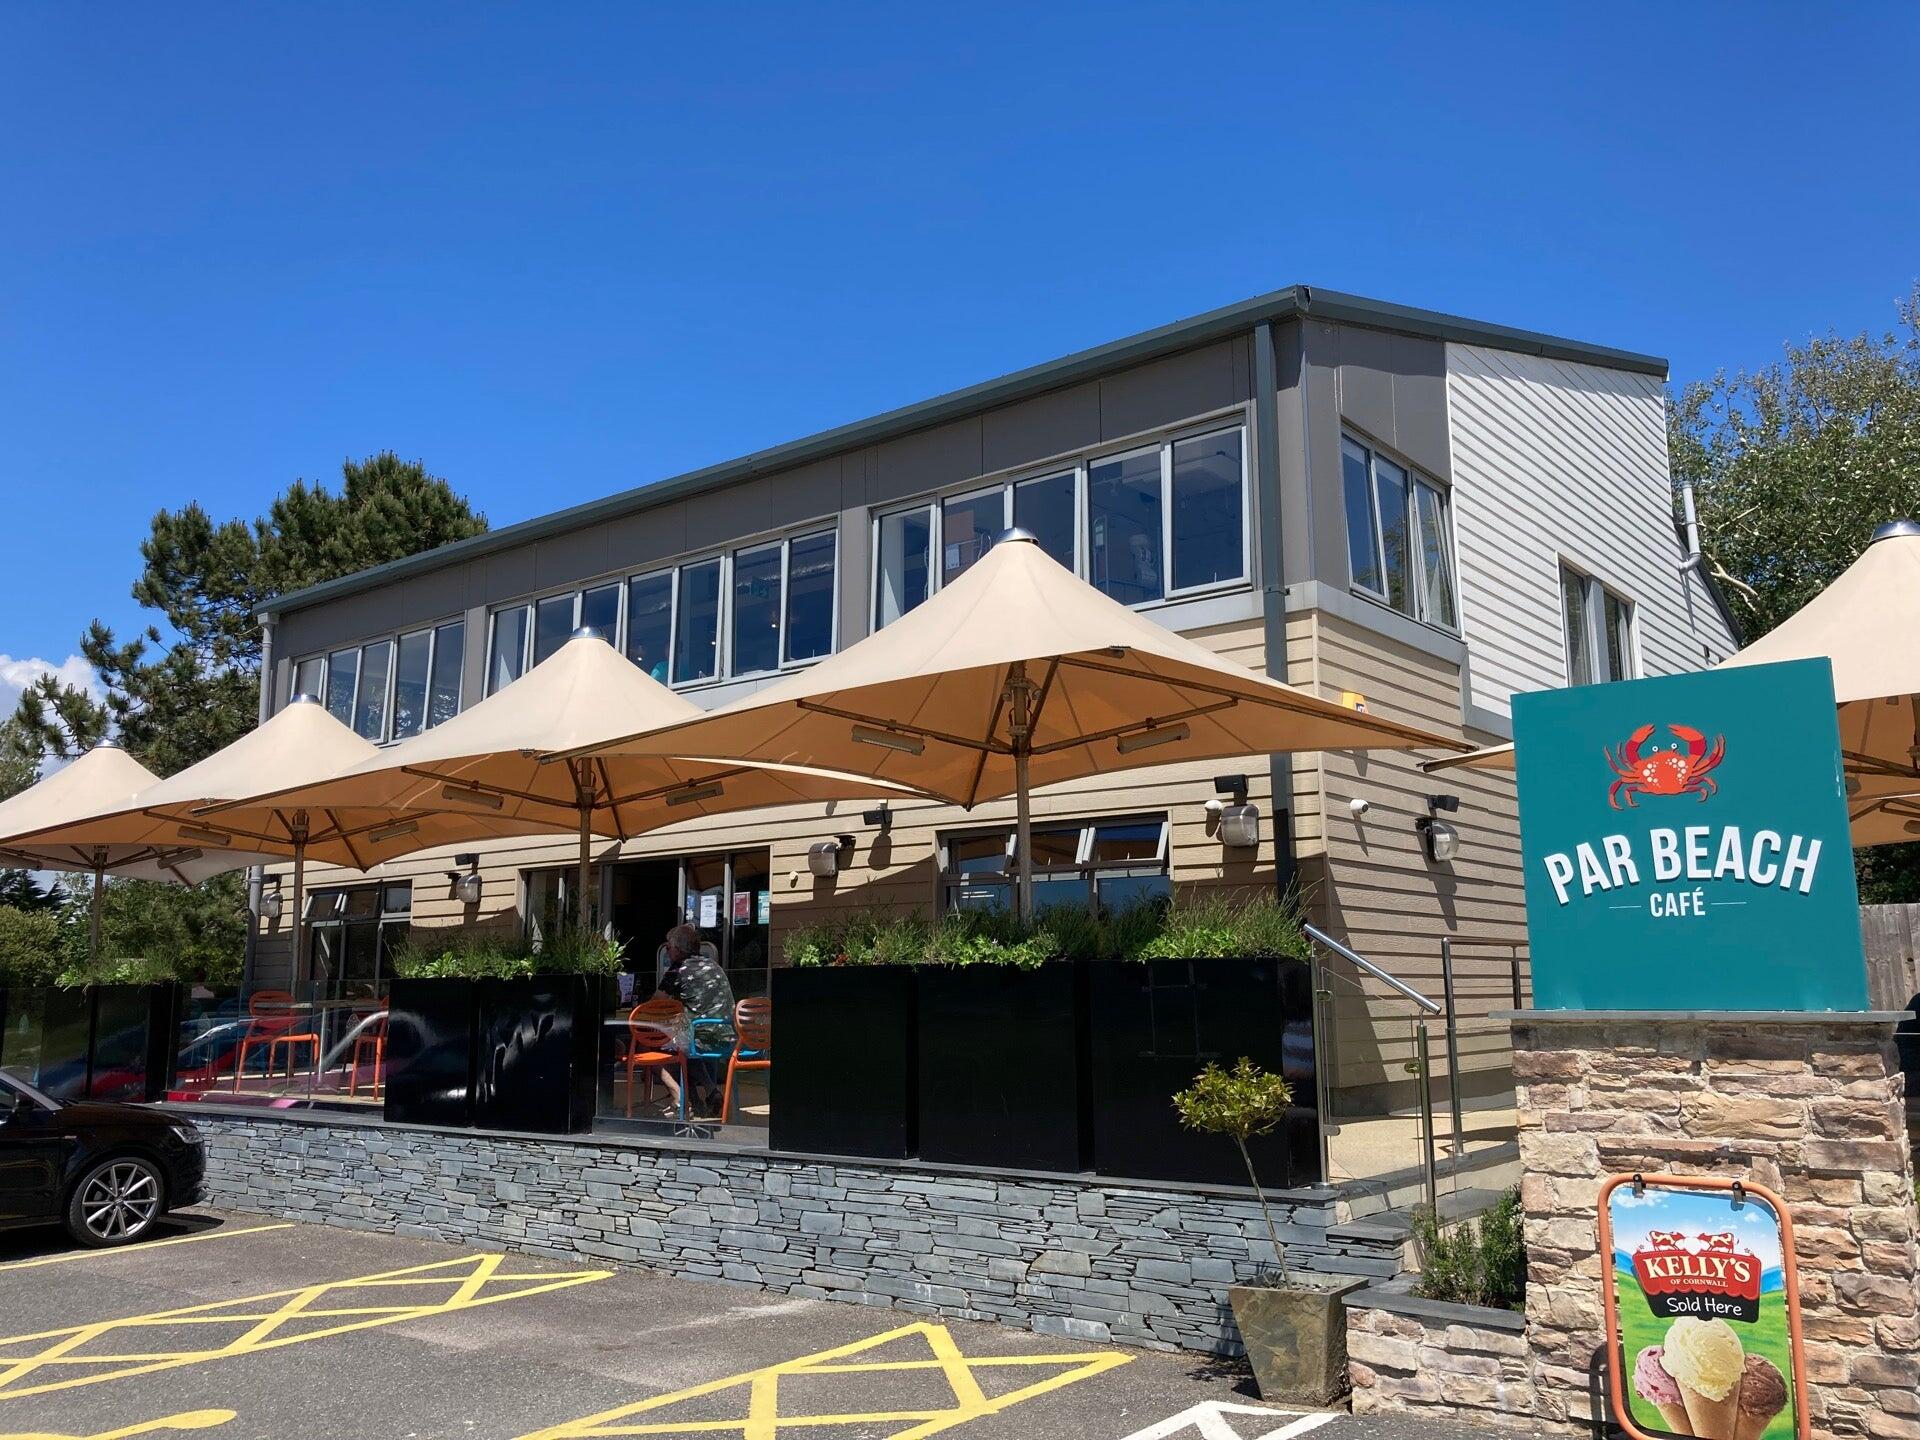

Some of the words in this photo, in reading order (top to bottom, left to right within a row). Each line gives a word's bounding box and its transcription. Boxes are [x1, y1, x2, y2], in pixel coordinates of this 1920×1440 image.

[1543, 834, 1640, 905] PAR
[1650, 826, 1822, 893] BEACH
[1650, 887, 1706, 918] CAFÉ
[1643, 1256, 1751, 1283] KELLY'S
[1683, 1278, 1728, 1287] CORNWALL
[1666, 1297, 1701, 1313] Sold
[1704, 1297, 1742, 1316] Here
